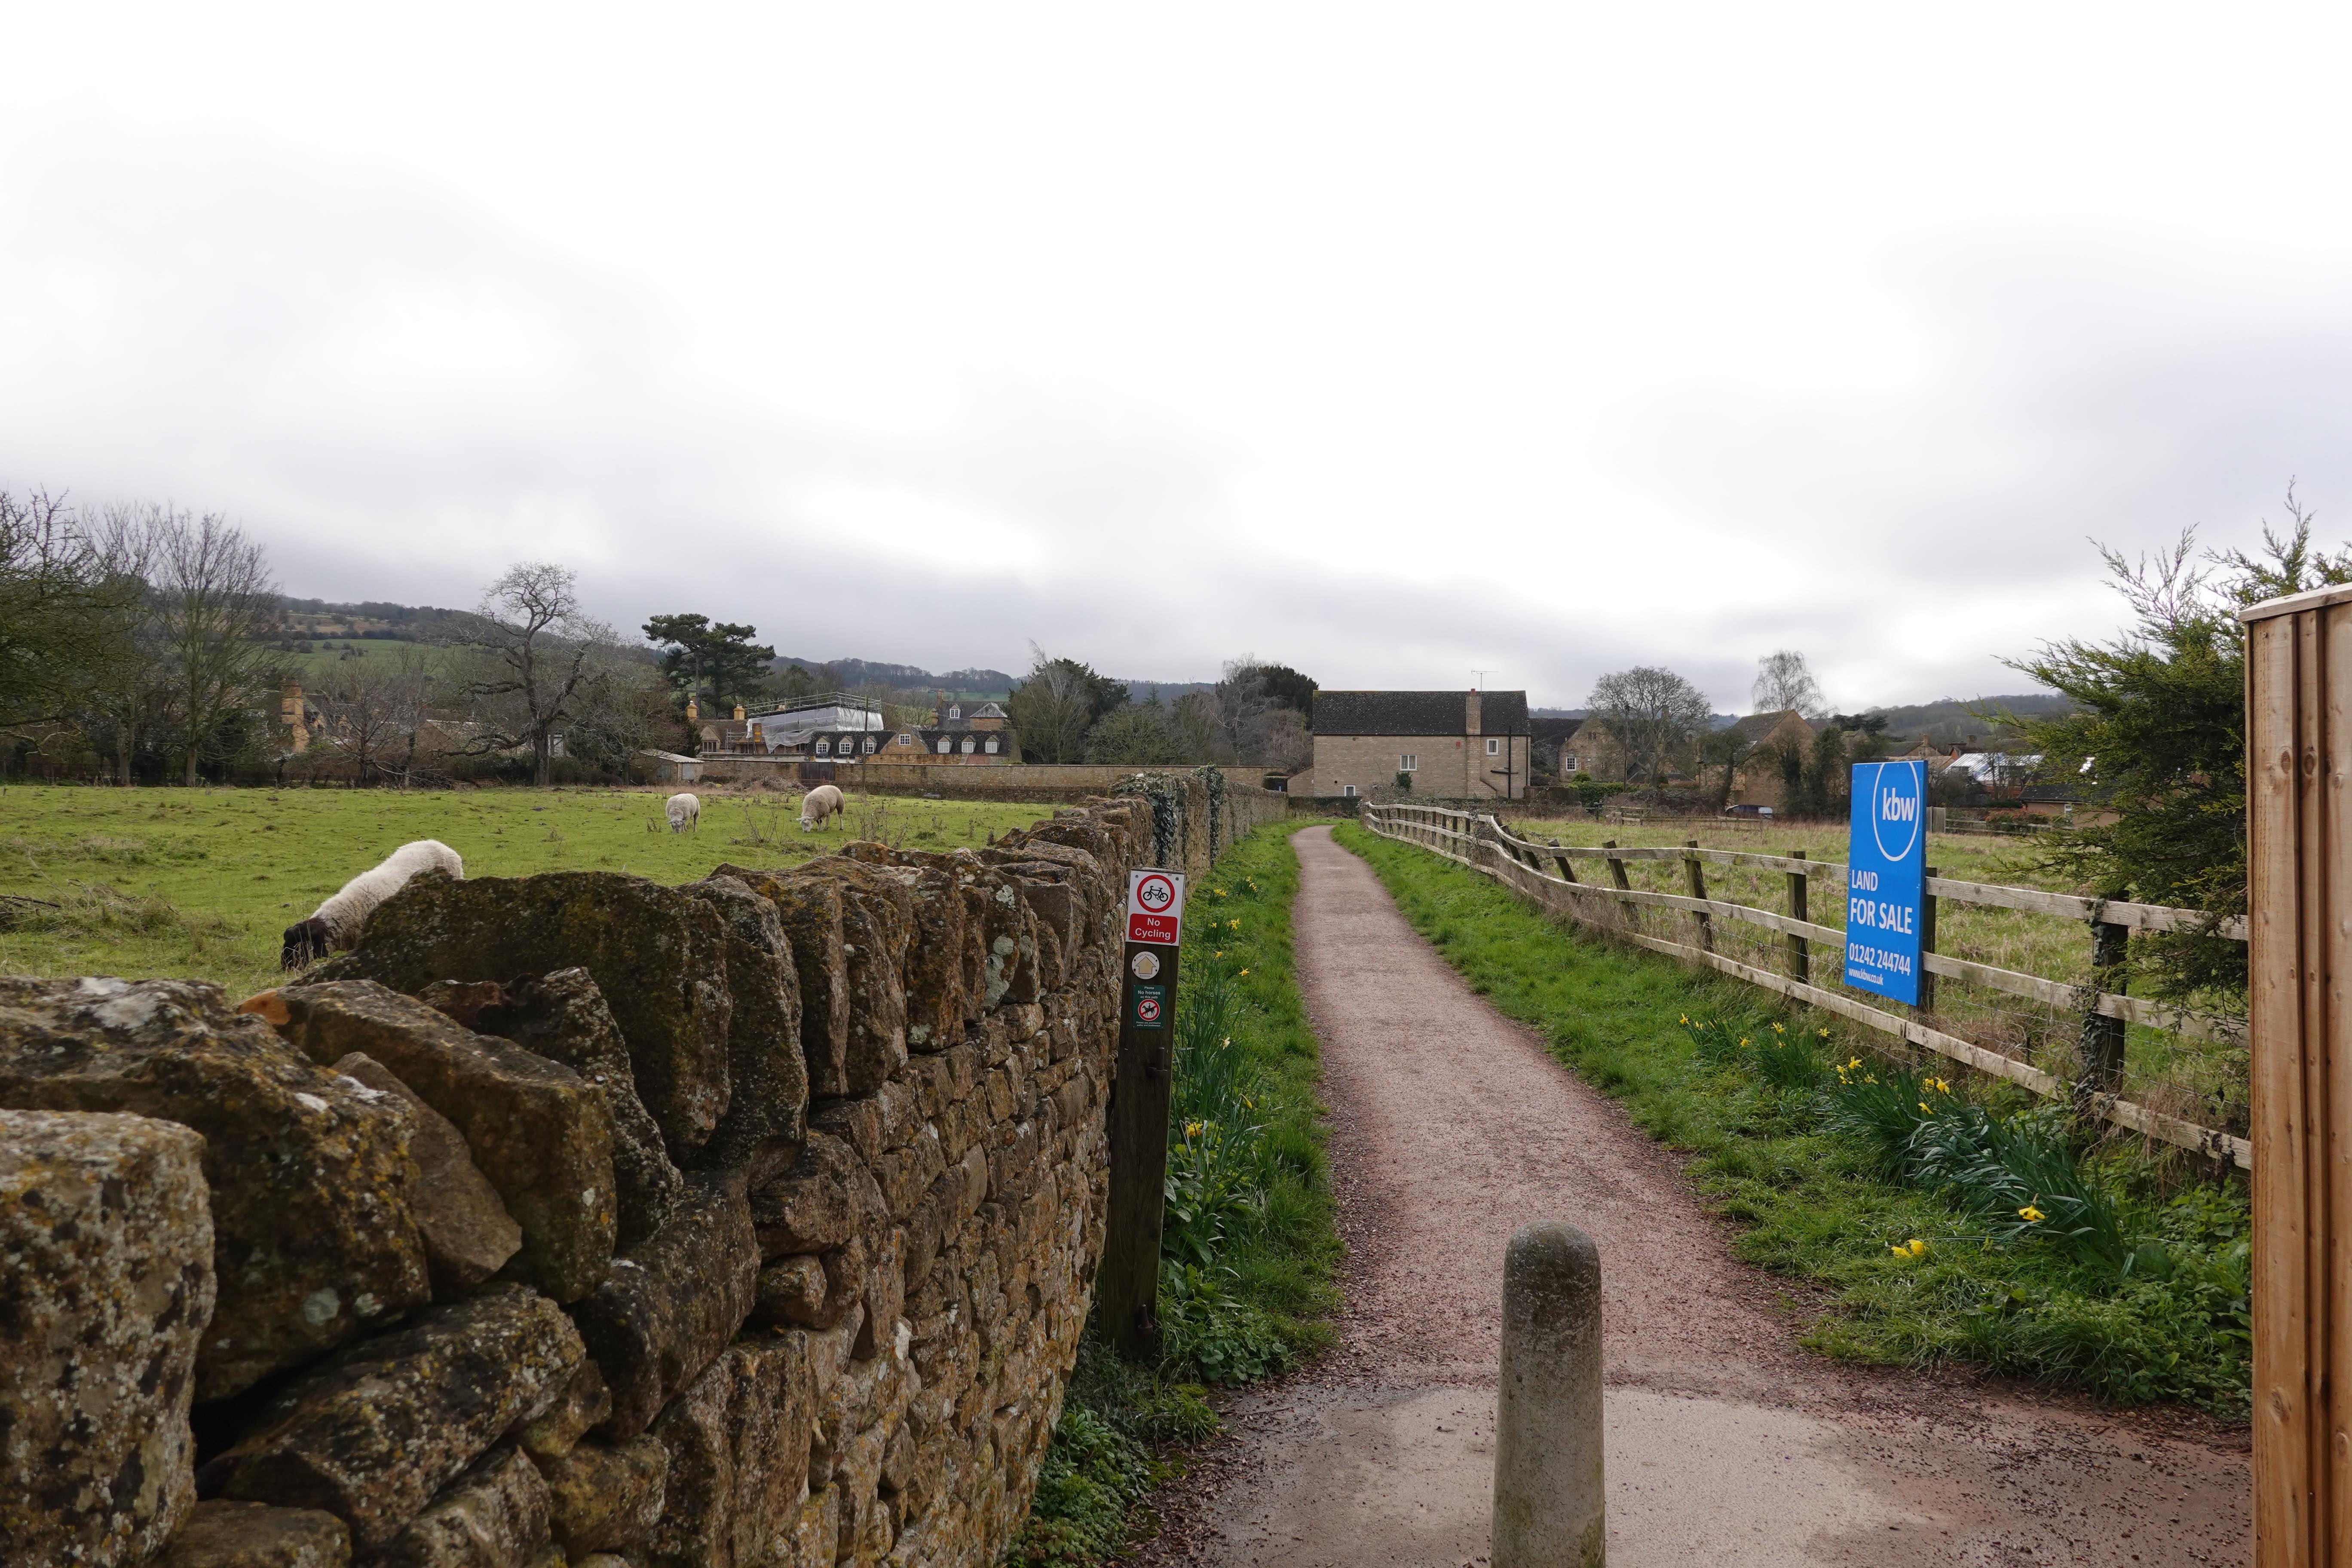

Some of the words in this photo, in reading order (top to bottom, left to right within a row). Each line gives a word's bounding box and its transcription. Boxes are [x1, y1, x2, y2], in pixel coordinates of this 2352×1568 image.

[1883, 787, 1915, 821] kbw
[1852, 870, 1878, 891] LAND
[1147, 918, 1160, 926] No
[1850, 897, 1875, 927] FOR
[1879, 903, 1912, 934] SALE
[1135, 928, 1170, 940] Cycling
[1849, 943, 1875, 966] 01242
[1877, 949, 1911, 976] 244744
[1848, 968, 1883, 985] www.kbw.co.uk
